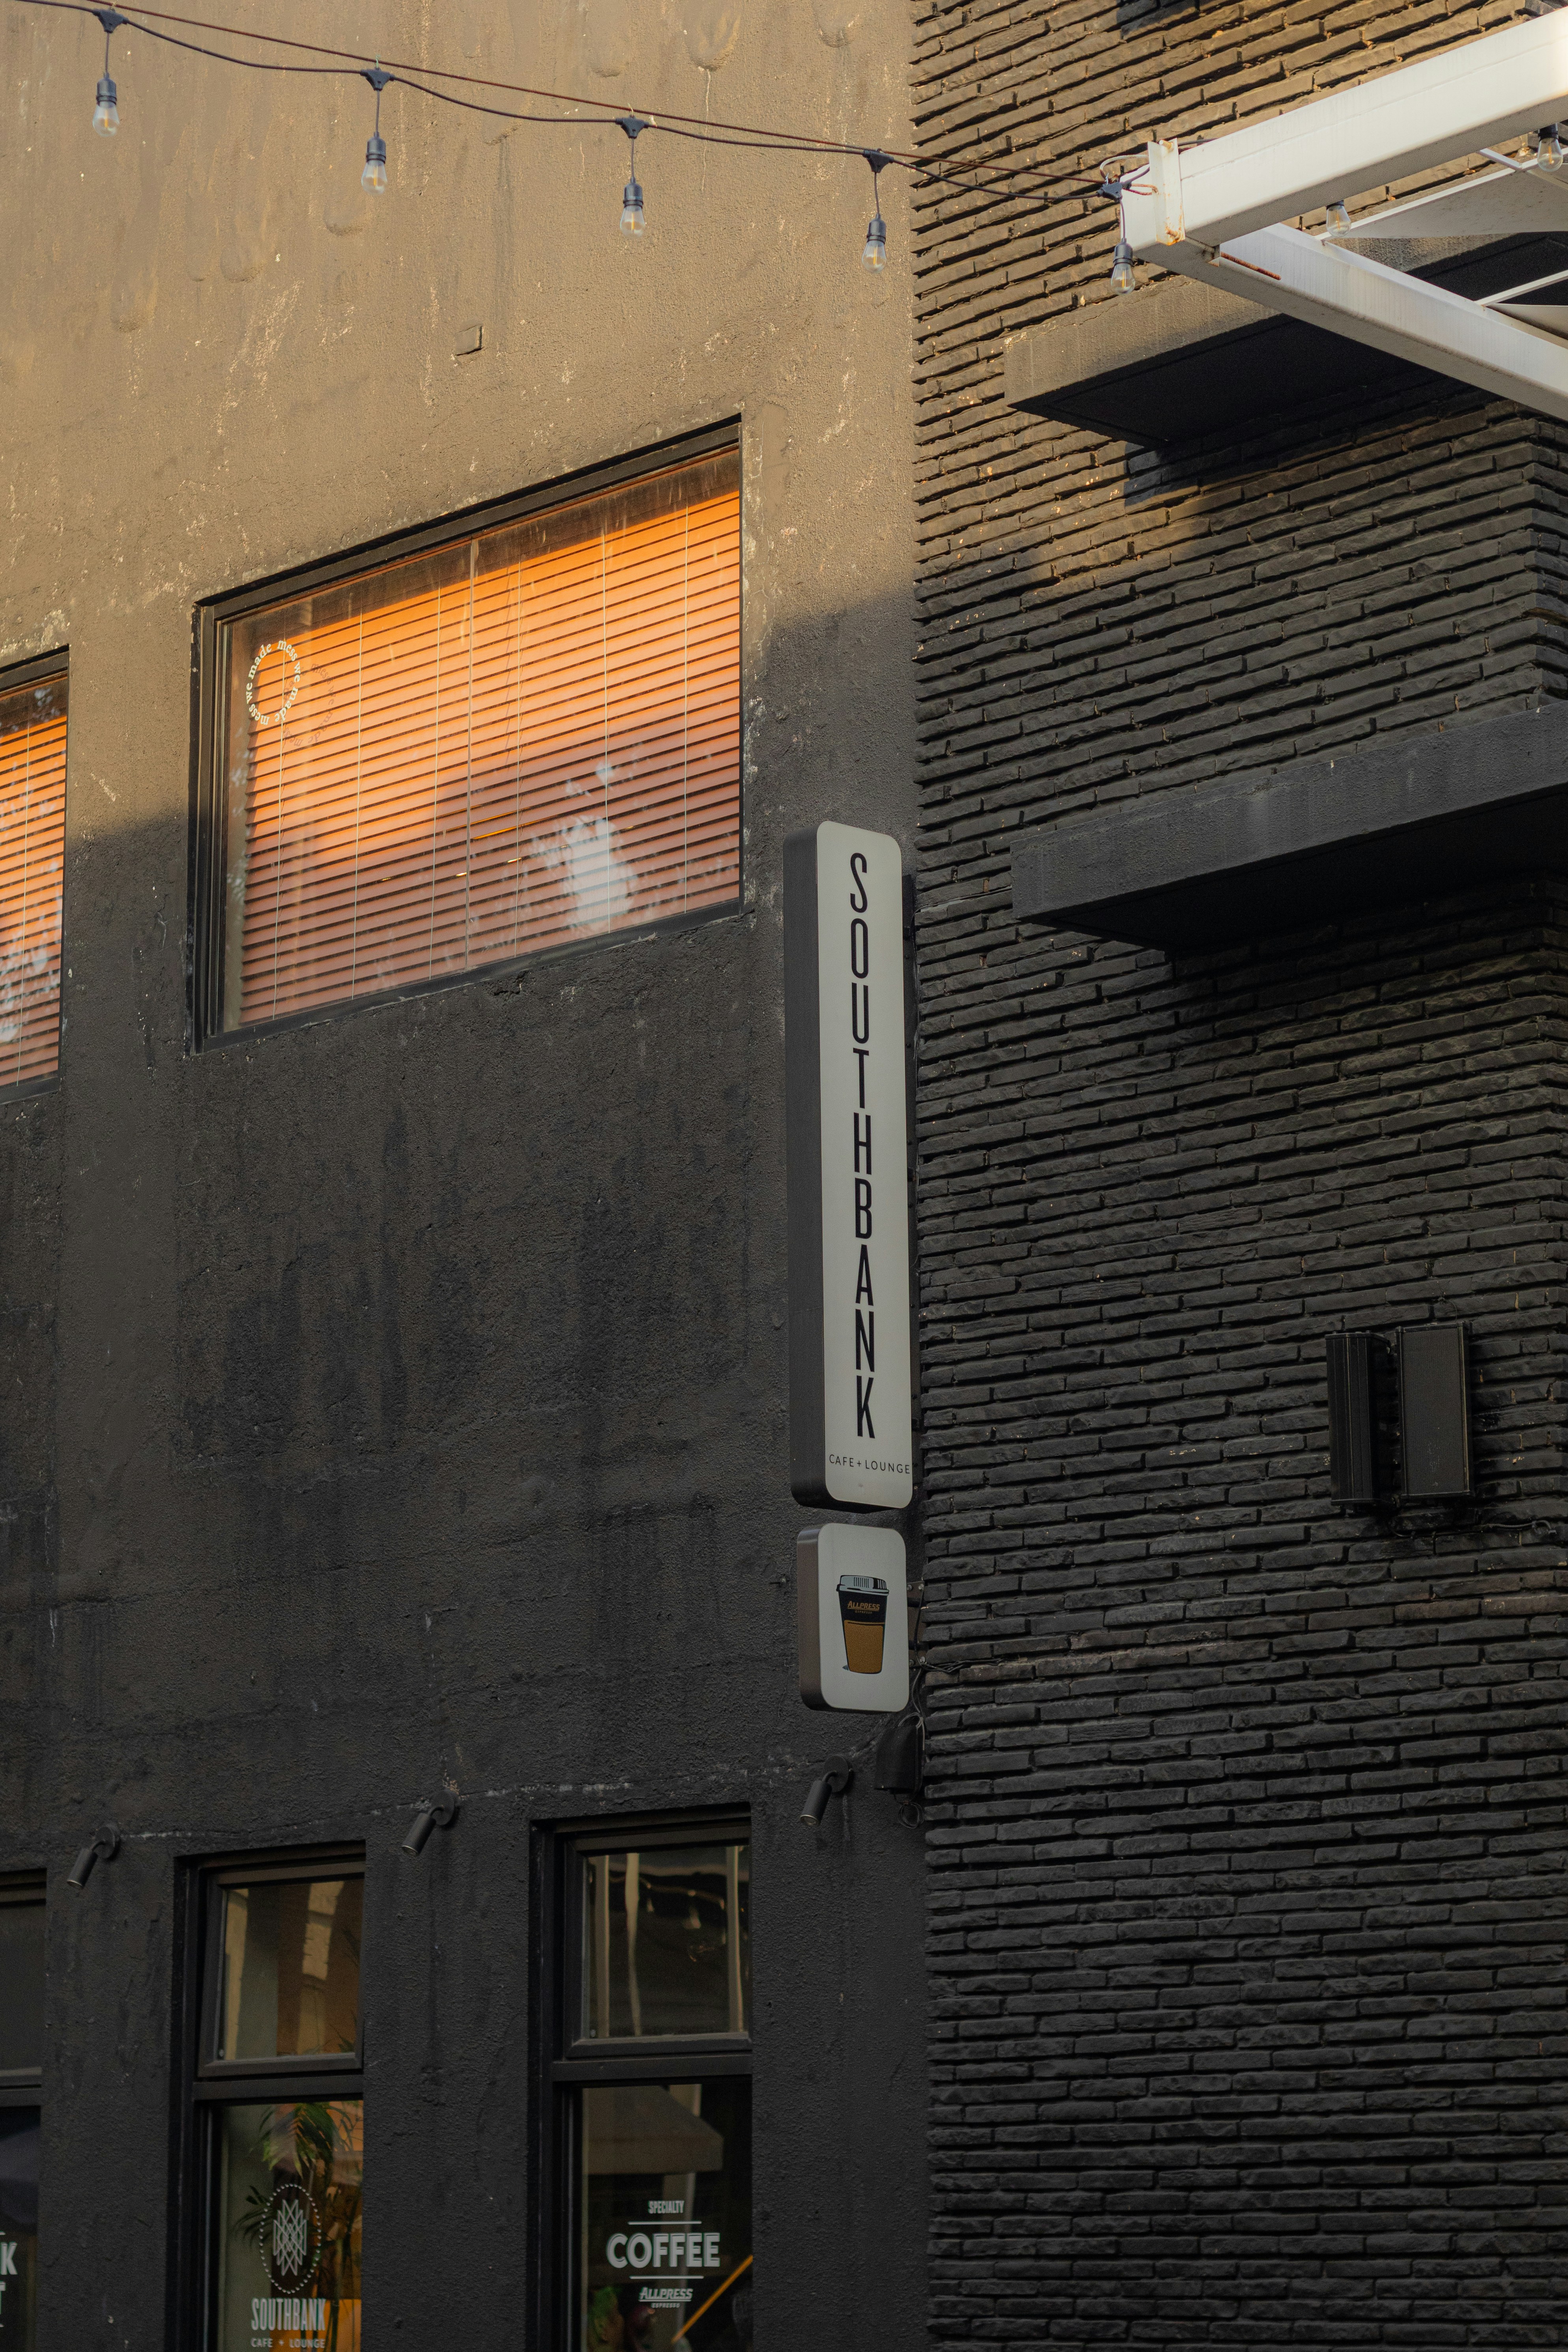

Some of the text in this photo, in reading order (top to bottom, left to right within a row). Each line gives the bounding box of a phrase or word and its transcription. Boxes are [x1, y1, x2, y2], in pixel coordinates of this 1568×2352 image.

[277, 640, 298, 661] mess
[248, 644, 272, 680] made
[294, 661, 301, 683] we
[246, 682, 253, 704] we
[249, 704, 269, 725] mess
[275, 686, 298, 722] made
[850, 853, 875, 1439] SOUTHBANK
[829, 1454, 854, 1467] CAFE
[865, 1460, 910, 1474] LOUNGE
[848, 1600, 880, 1610] ALLPRESS
[648, 2200, 685, 2214] SPECIALTY
[606, 2232, 720, 2268] COFFEE
[639, 2287, 693, 2300] ALLPRESS
[251, 2298, 326, 2331] SOUTHBANK
[251, 2338, 273, 2348] CAFE
[288, 2338, 326, 2348] LOUNGE
